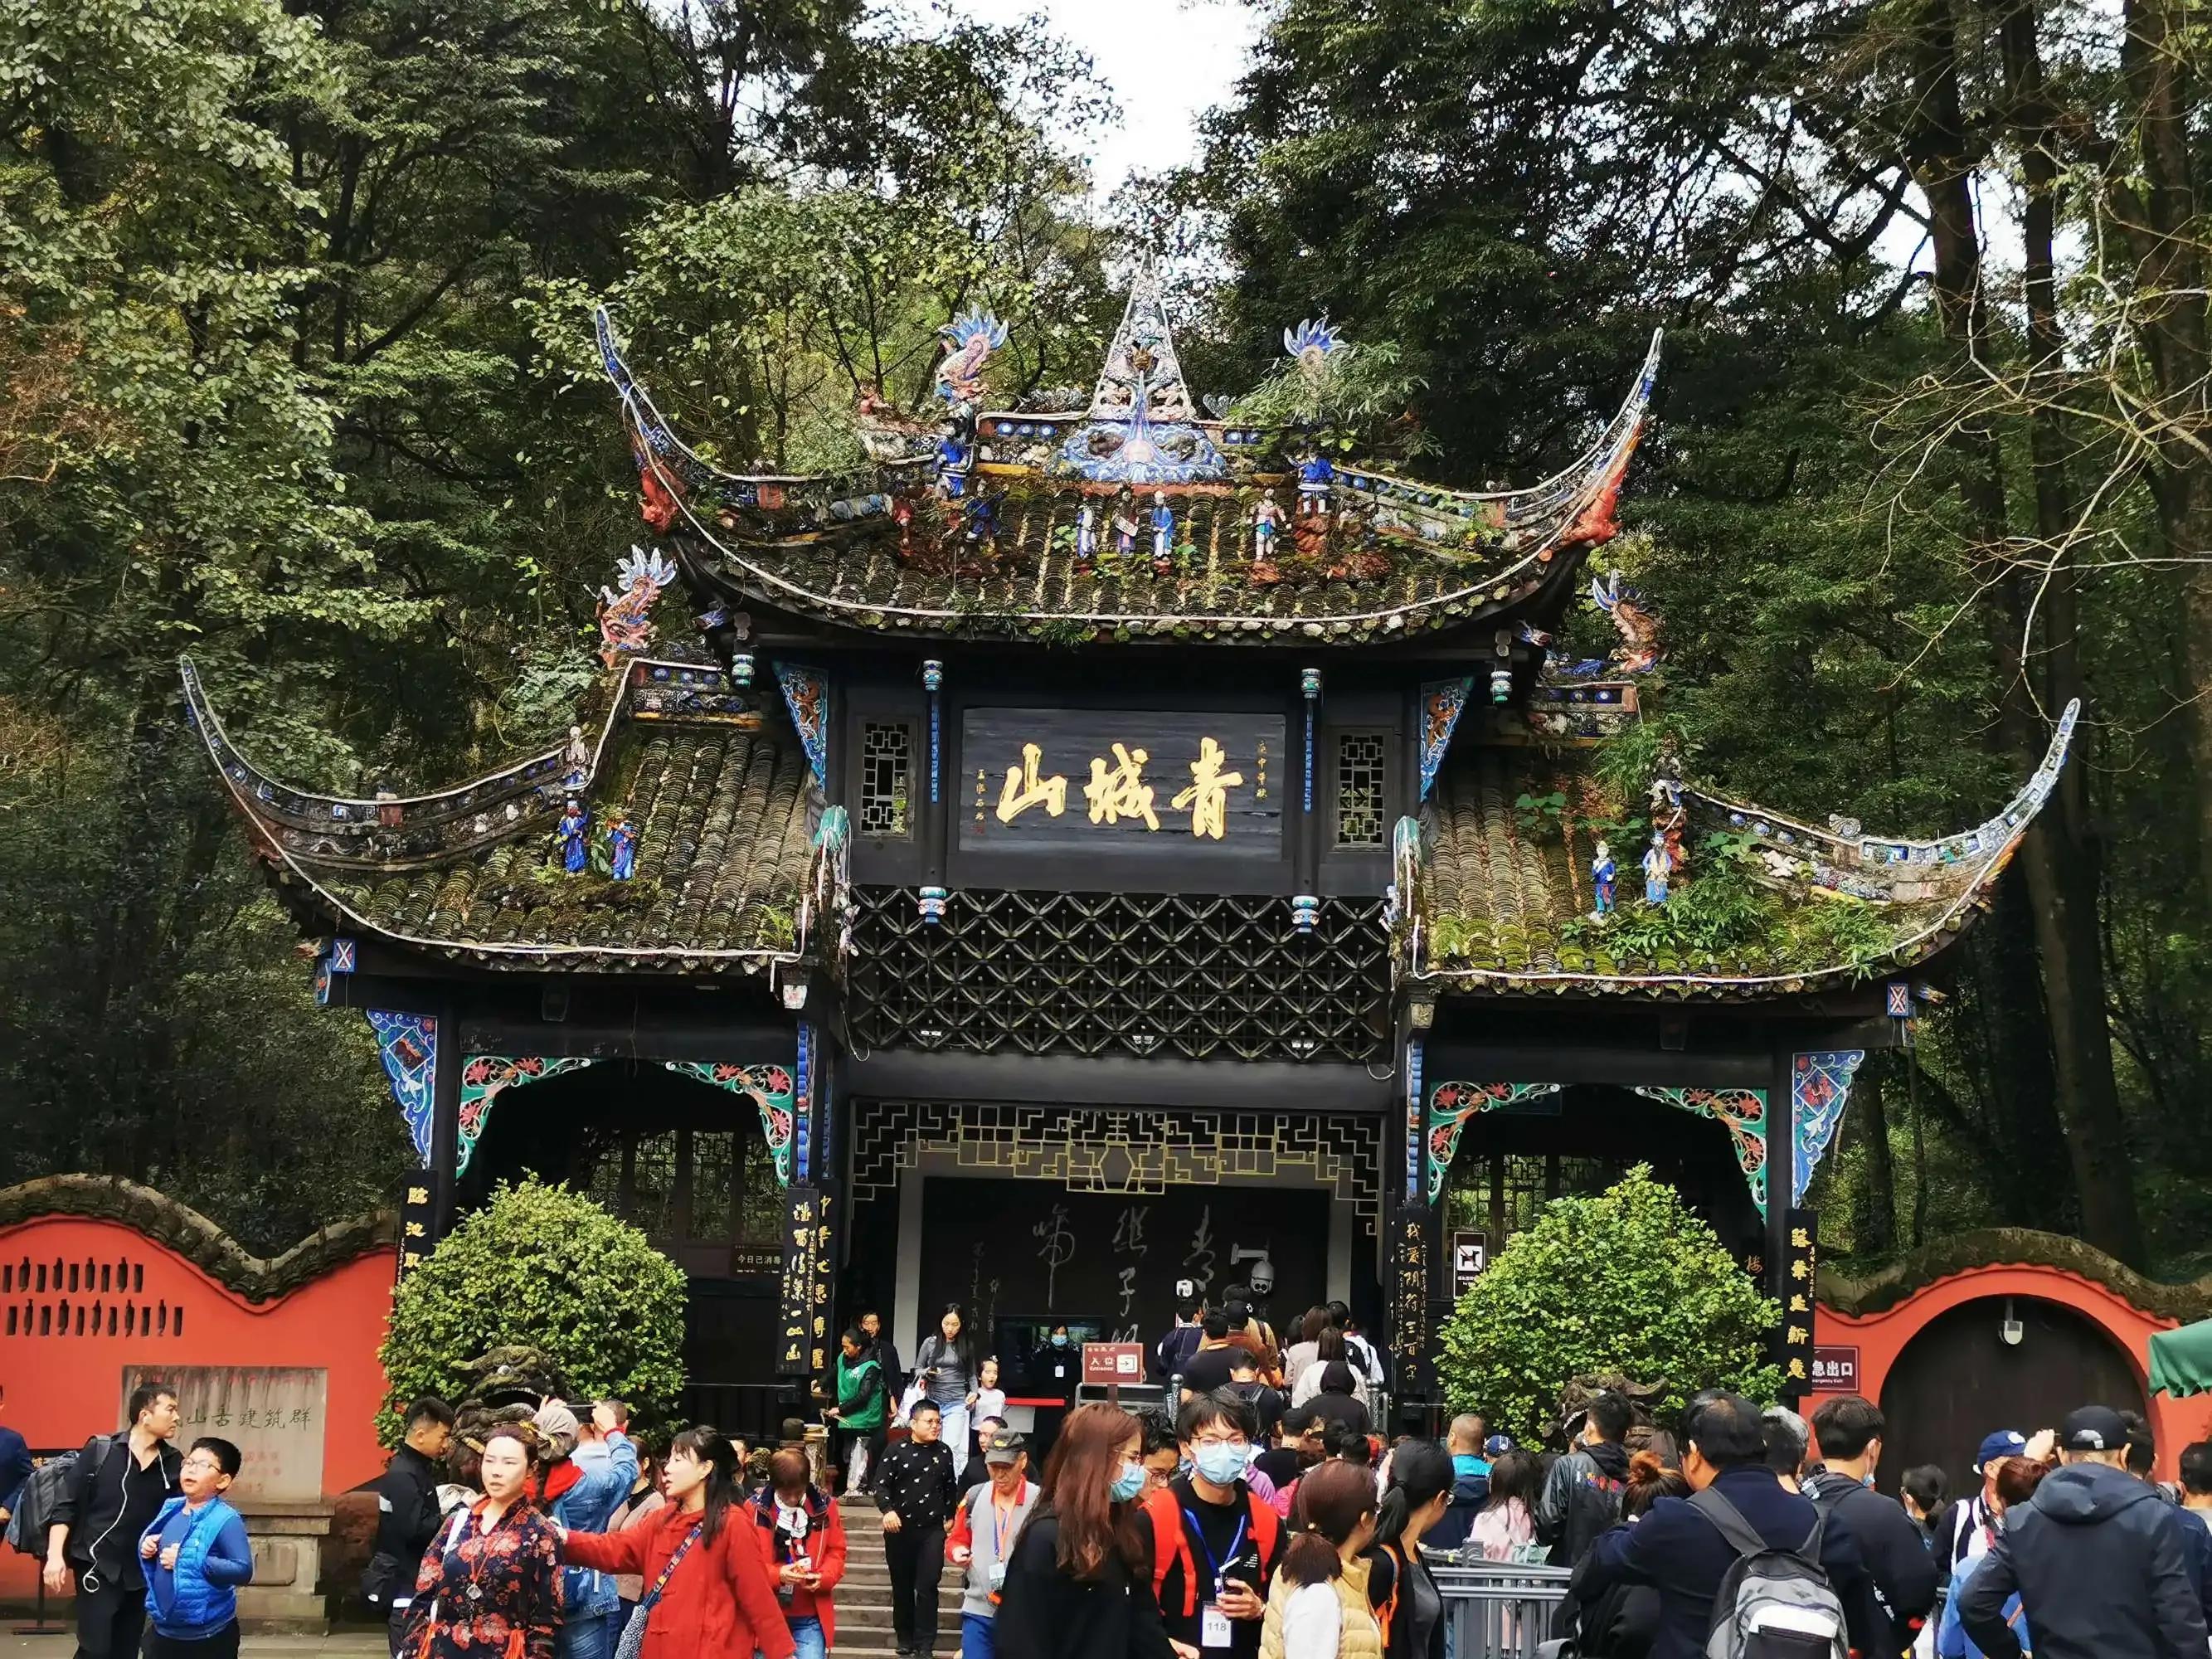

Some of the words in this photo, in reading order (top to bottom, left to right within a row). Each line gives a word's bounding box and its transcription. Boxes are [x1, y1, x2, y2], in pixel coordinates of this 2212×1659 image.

[995, 737, 1243, 840] 青城山
[1090, 1356, 1113, 1365] 入口
[1812, 1360, 1853, 1376] 急出口
[177, 1407, 313, 1430] 山古建筑群
[1208, 1623, 1227, 1632] 118
